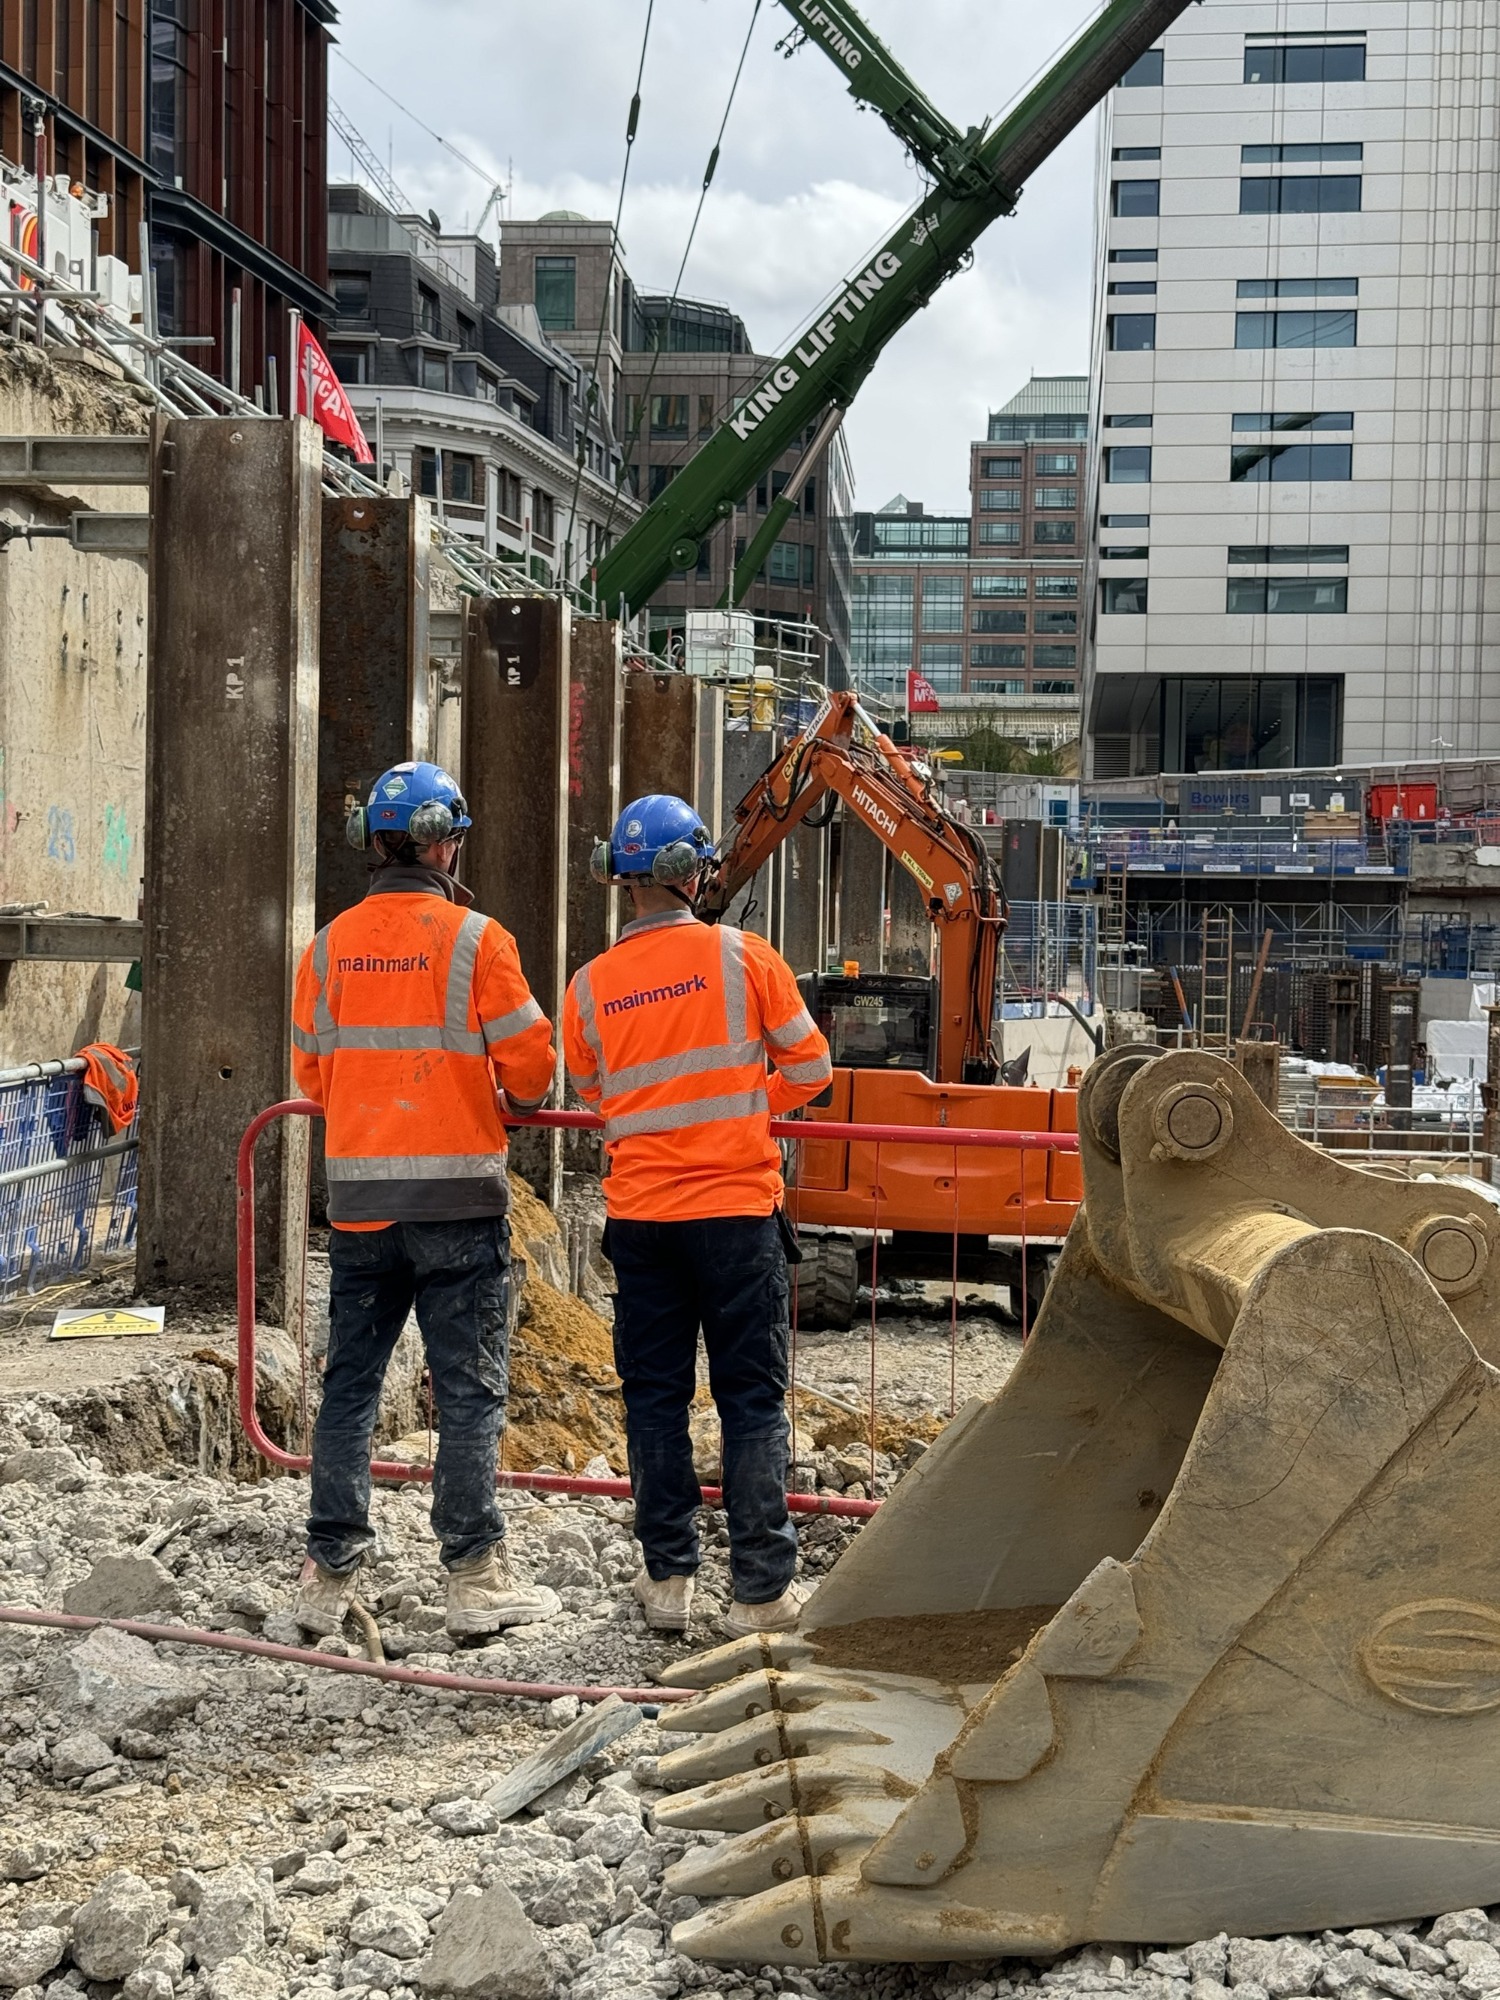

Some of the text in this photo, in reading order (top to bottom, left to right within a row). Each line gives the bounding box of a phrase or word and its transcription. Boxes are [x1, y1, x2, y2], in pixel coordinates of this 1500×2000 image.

[798, 0, 862, 70] LIFTING
[729, 251, 903, 441] KING LIFTING
[226, 655, 245, 699] KP 1
[507, 655, 521, 686] KP 1
[805, 703, 830, 741] HITACHI
[851, 784, 898, 838] HITACHI
[1190, 792, 1250, 804] Bowers
[337, 952, 430, 973] mainmark
[602, 974, 708, 1017] mainmark
[853, 995, 884, 1007] GW245
